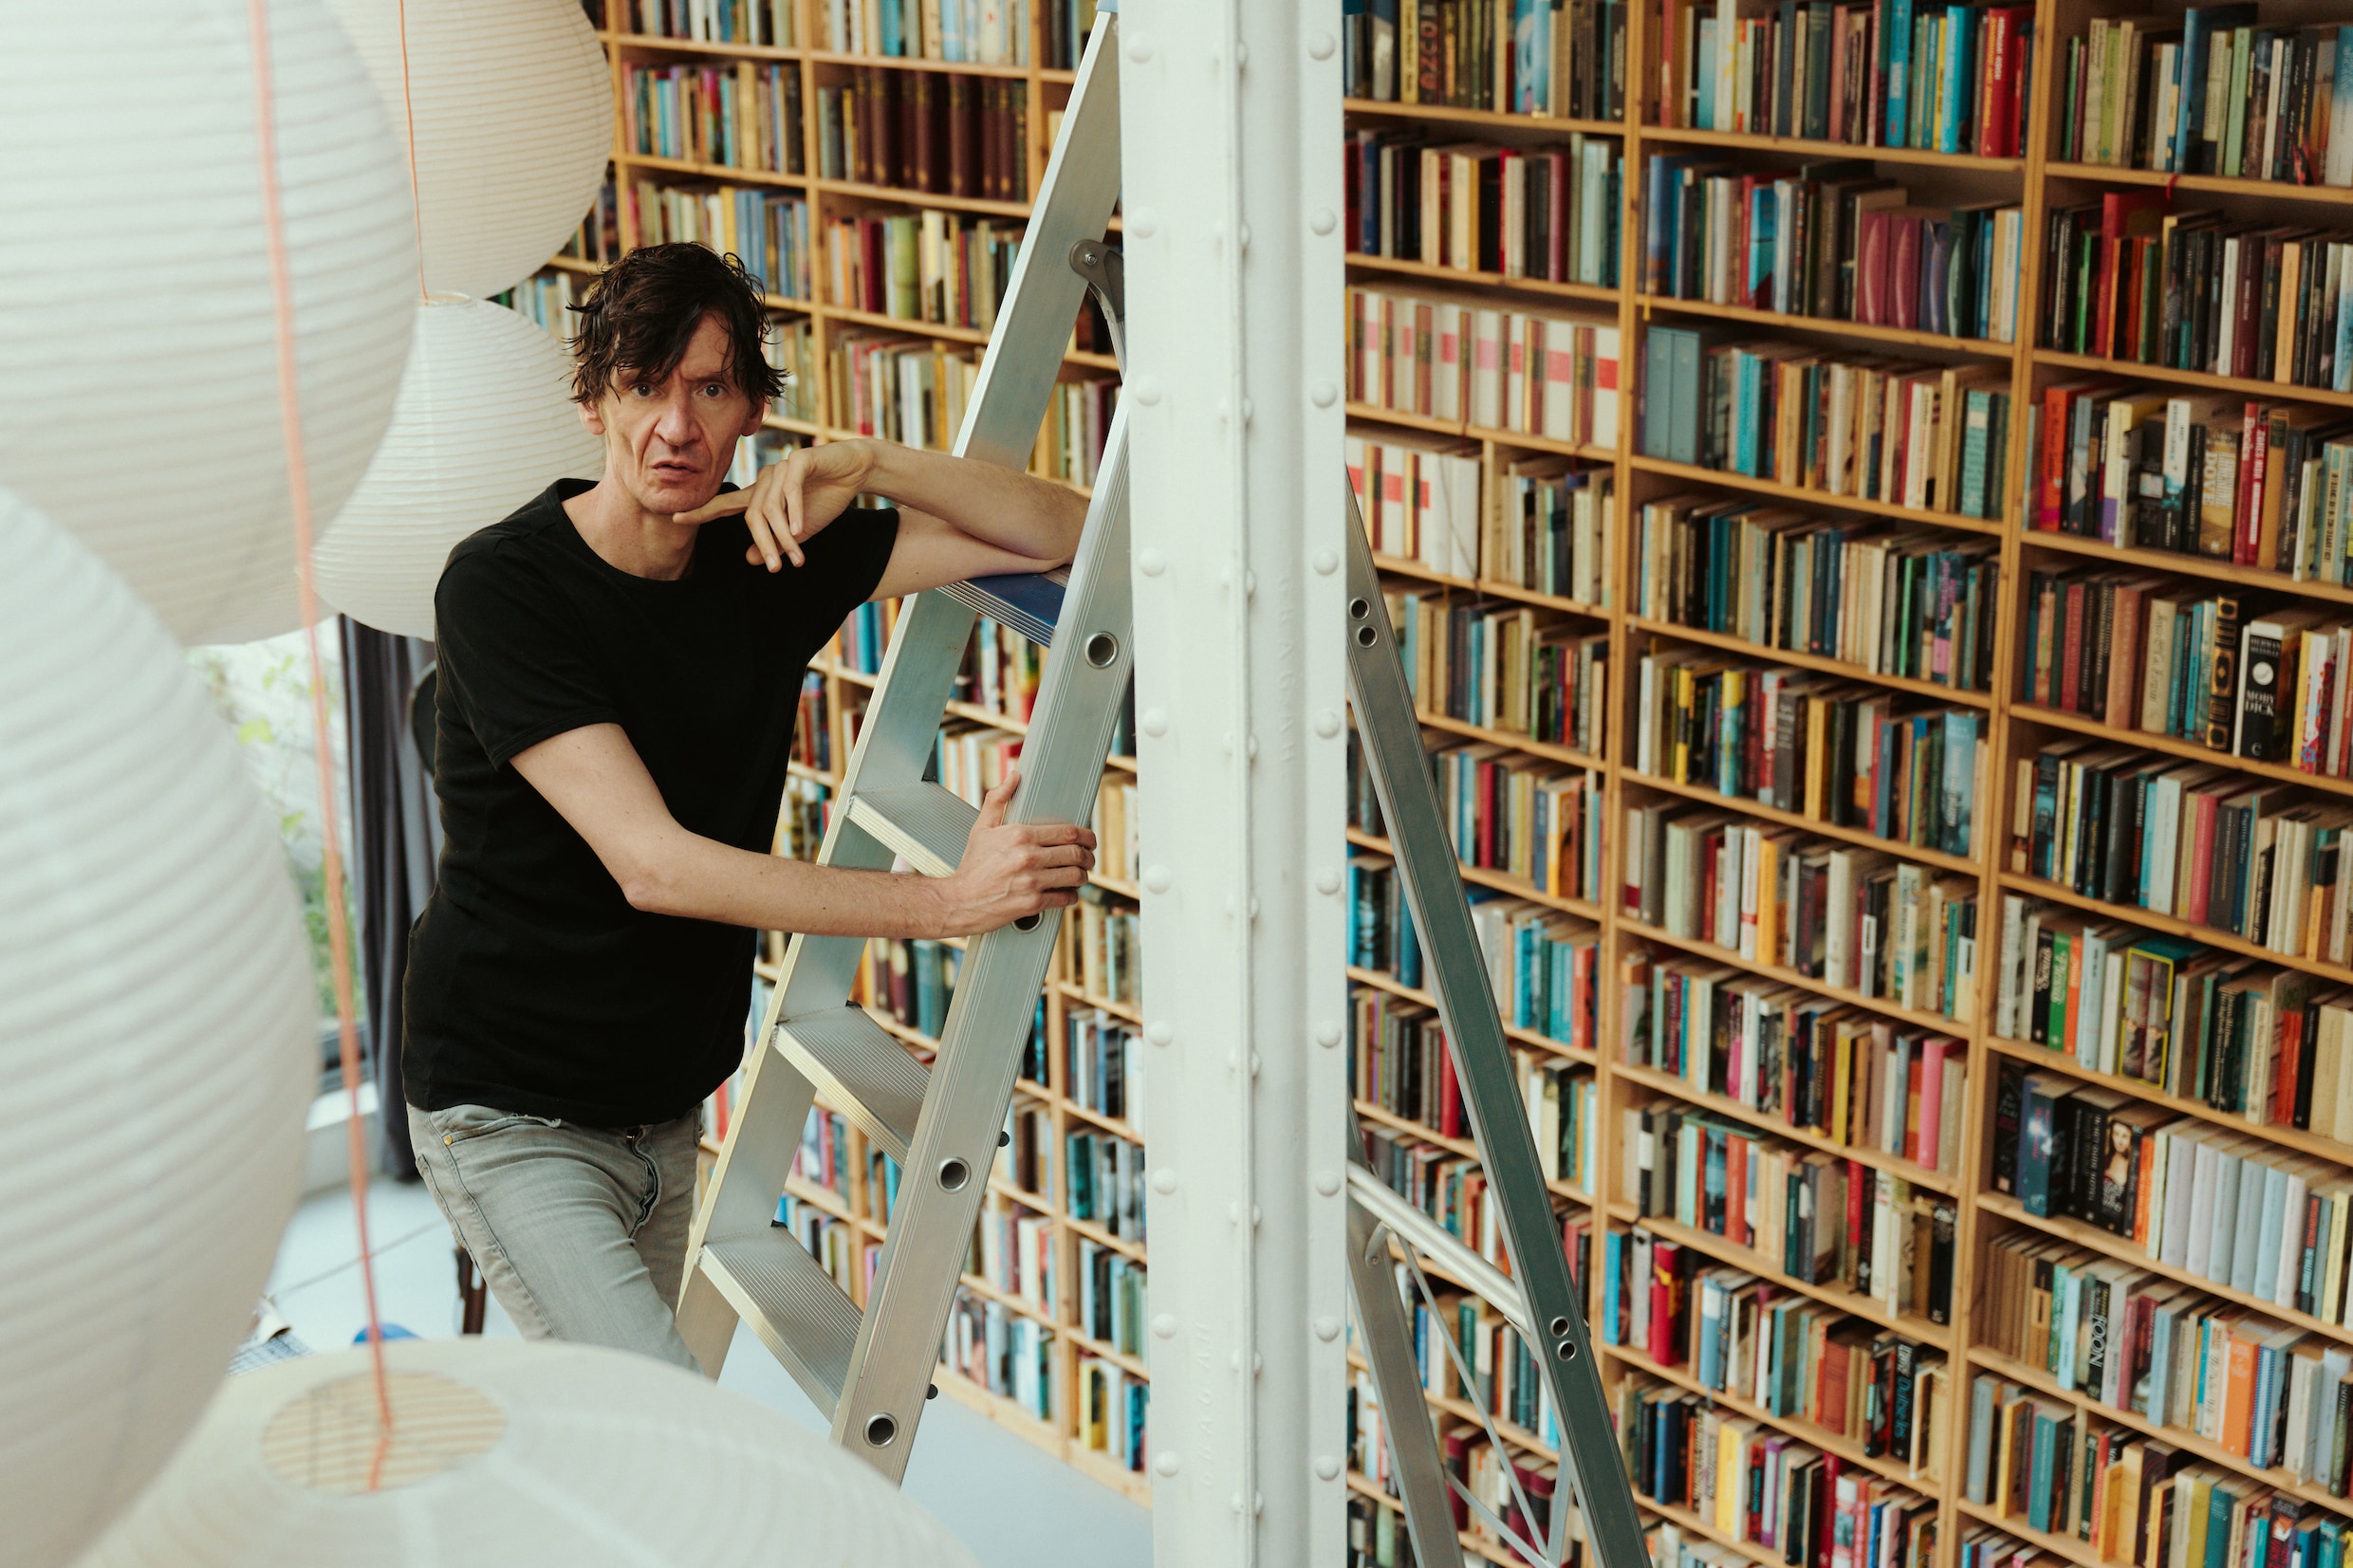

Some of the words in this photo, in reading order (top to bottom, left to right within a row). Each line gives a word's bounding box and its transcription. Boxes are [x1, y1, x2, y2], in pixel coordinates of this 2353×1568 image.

[2201, 450, 2218, 506] DOVE
[2246, 689, 2275, 706] MOBY
[2244, 700, 2275, 718] DICK
